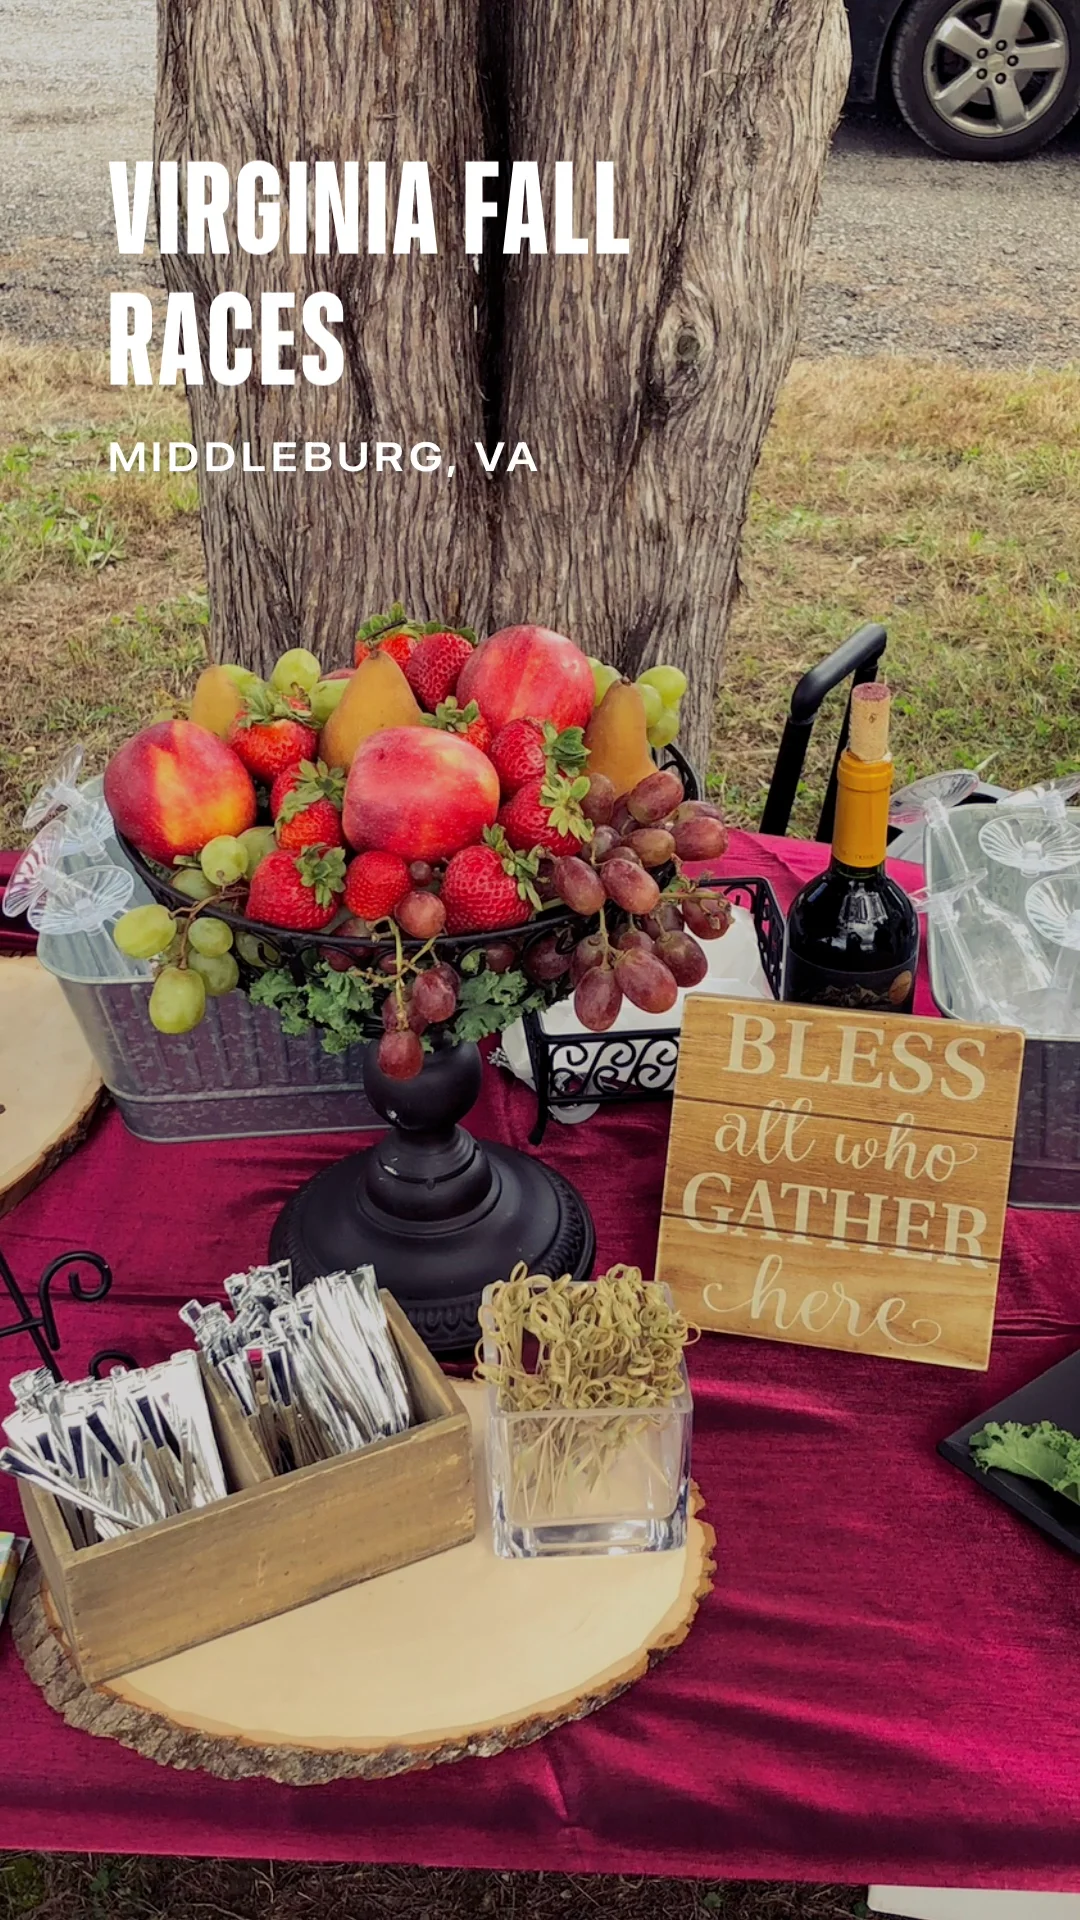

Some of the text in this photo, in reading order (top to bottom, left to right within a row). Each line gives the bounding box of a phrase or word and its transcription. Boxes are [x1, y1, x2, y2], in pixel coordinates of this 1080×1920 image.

[722, 1013, 985, 1101] BLESS
[715, 1098, 978, 1182] all who
[682, 1172, 989, 1269] GATHER
[703, 1254, 942, 1347] here
